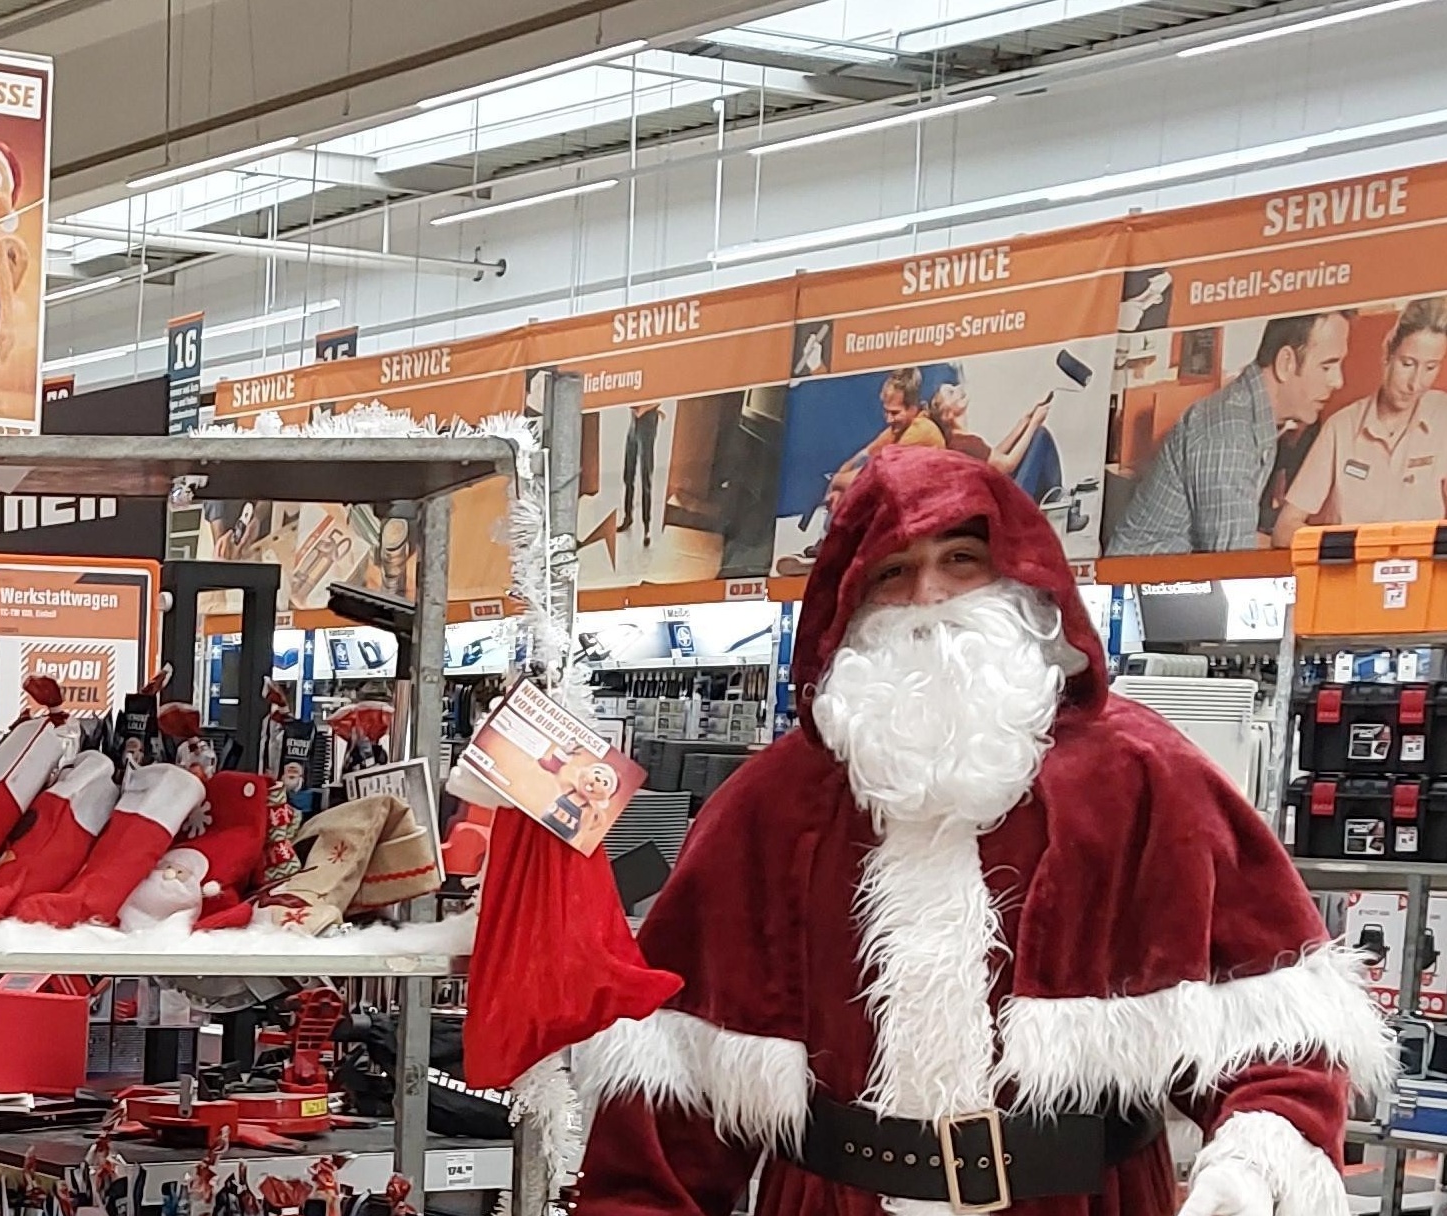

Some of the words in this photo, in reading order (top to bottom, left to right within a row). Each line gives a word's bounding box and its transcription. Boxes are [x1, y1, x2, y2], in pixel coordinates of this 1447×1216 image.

[1264, 177, 1408, 237] SERVICE
[902, 246, 1011, 295] SERVICE
[1190, 261, 1351, 306] Bestell-Service
[611, 300, 701, 343] SERVICE
[845, 309, 1026, 357] Renovierungs-Service
[173, 329, 198, 371] 16
[380, 347, 452, 383] SERVICE
[232, 374, 295, 407] SERVICE
[0, 588, 118, 611] Werkstattwagen
[36, 658, 101, 683] heyOBI
[512, 695, 535, 719] VOM
